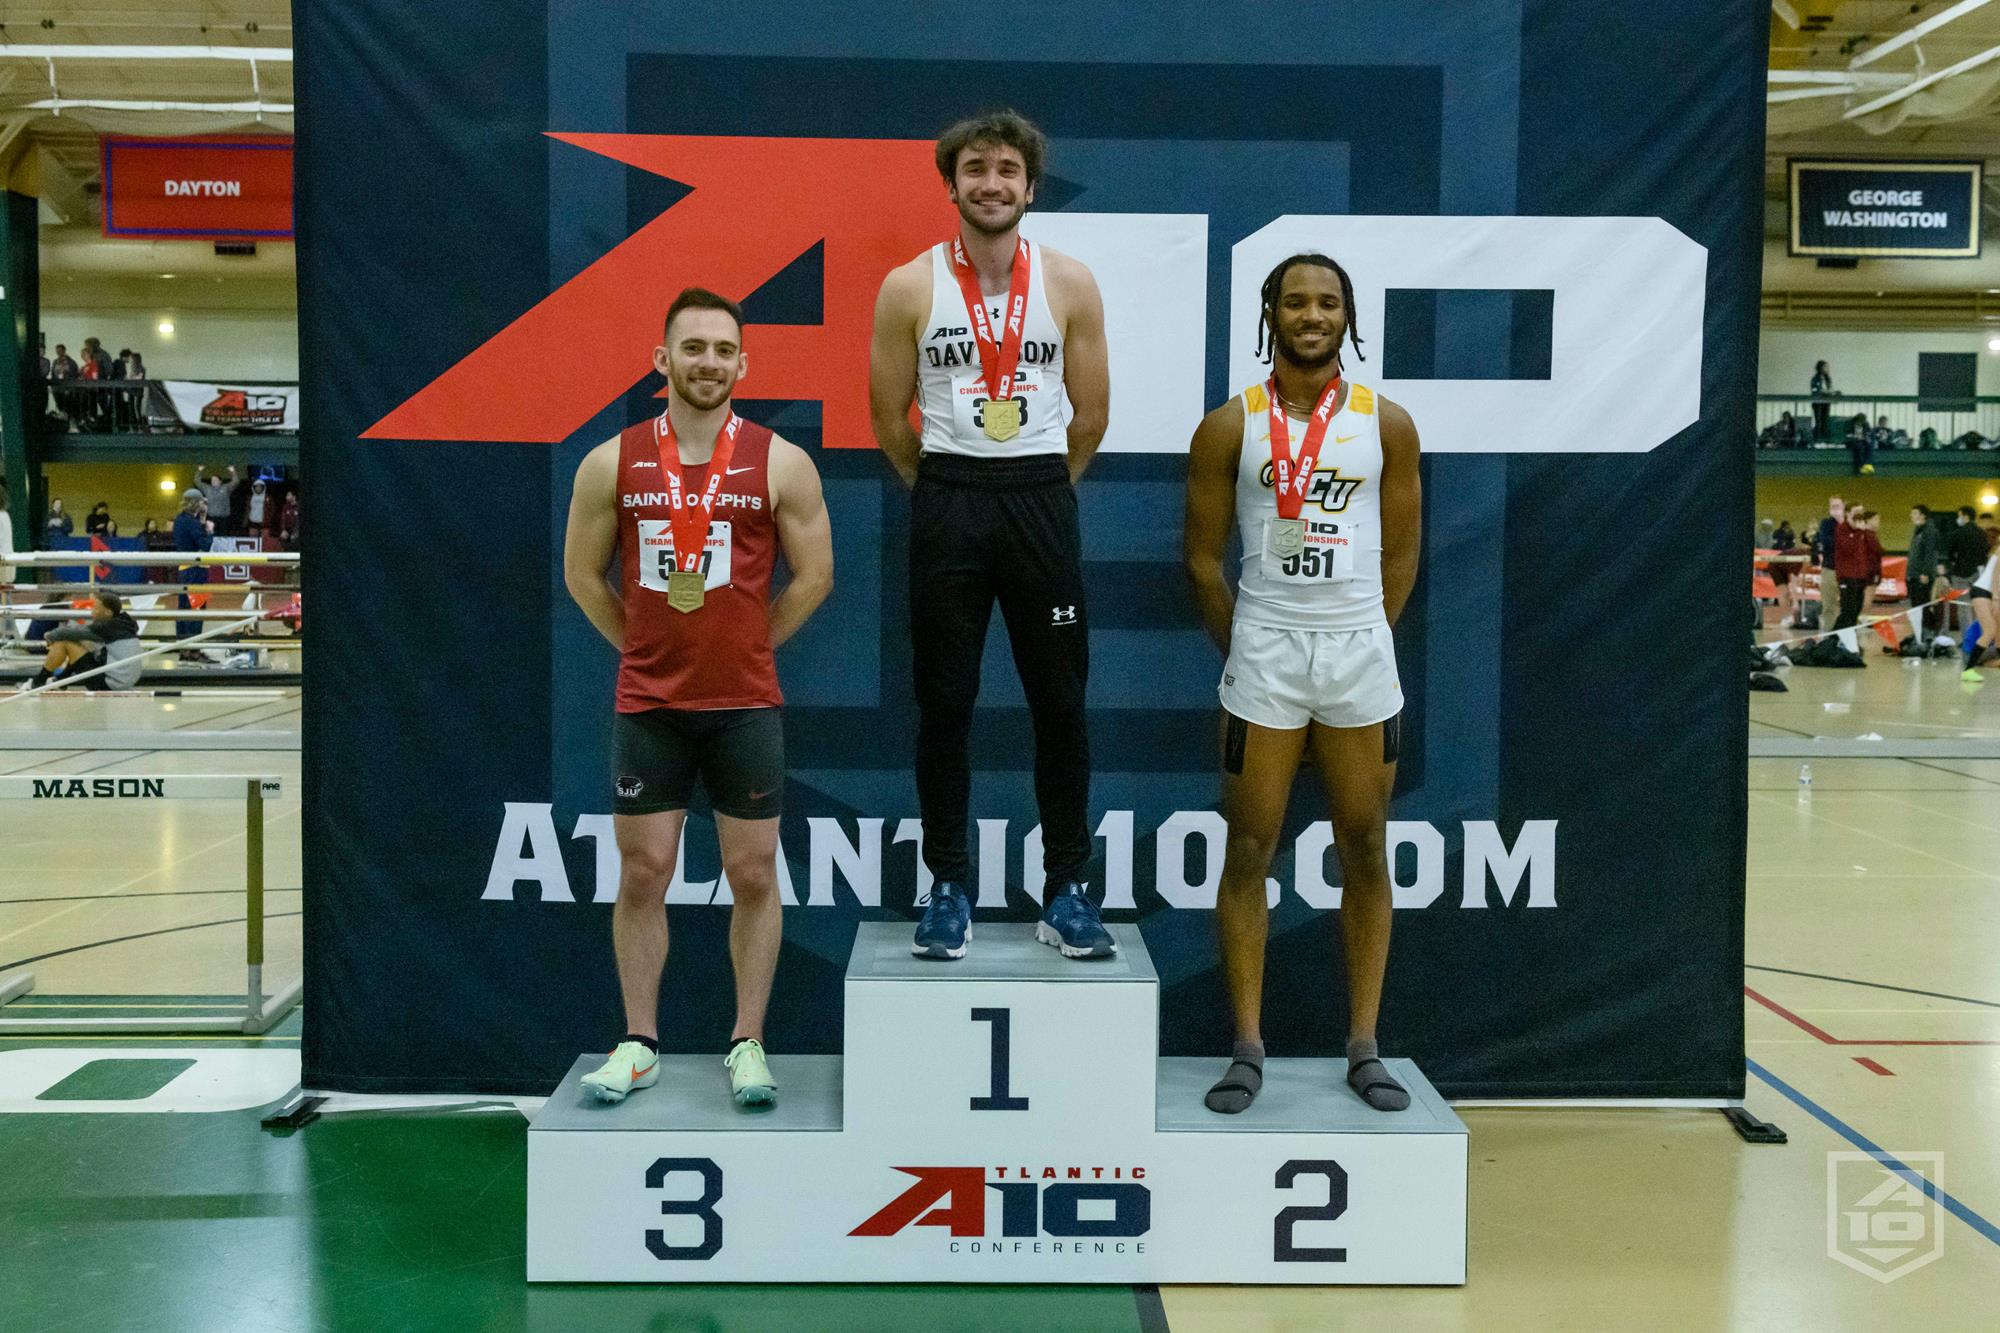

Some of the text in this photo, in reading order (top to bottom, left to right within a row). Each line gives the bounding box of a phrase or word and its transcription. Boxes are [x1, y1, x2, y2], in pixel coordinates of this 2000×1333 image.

[164, 180, 240, 196] DAYTON
[1848, 190, 1923, 206] GEORGE
[1823, 211, 1947, 228] WASHINGTON
[926, 341, 1057, 368] DAVON
[33, 779, 164, 798] MASON
[617, 787, 638, 797] SJU
[970, 1007, 1029, 1111] 1
[645, 1157, 723, 1260] 3
[1274, 1160, 1348, 1262] 2
[950, 1242, 1146, 1254] CONFERENCE
